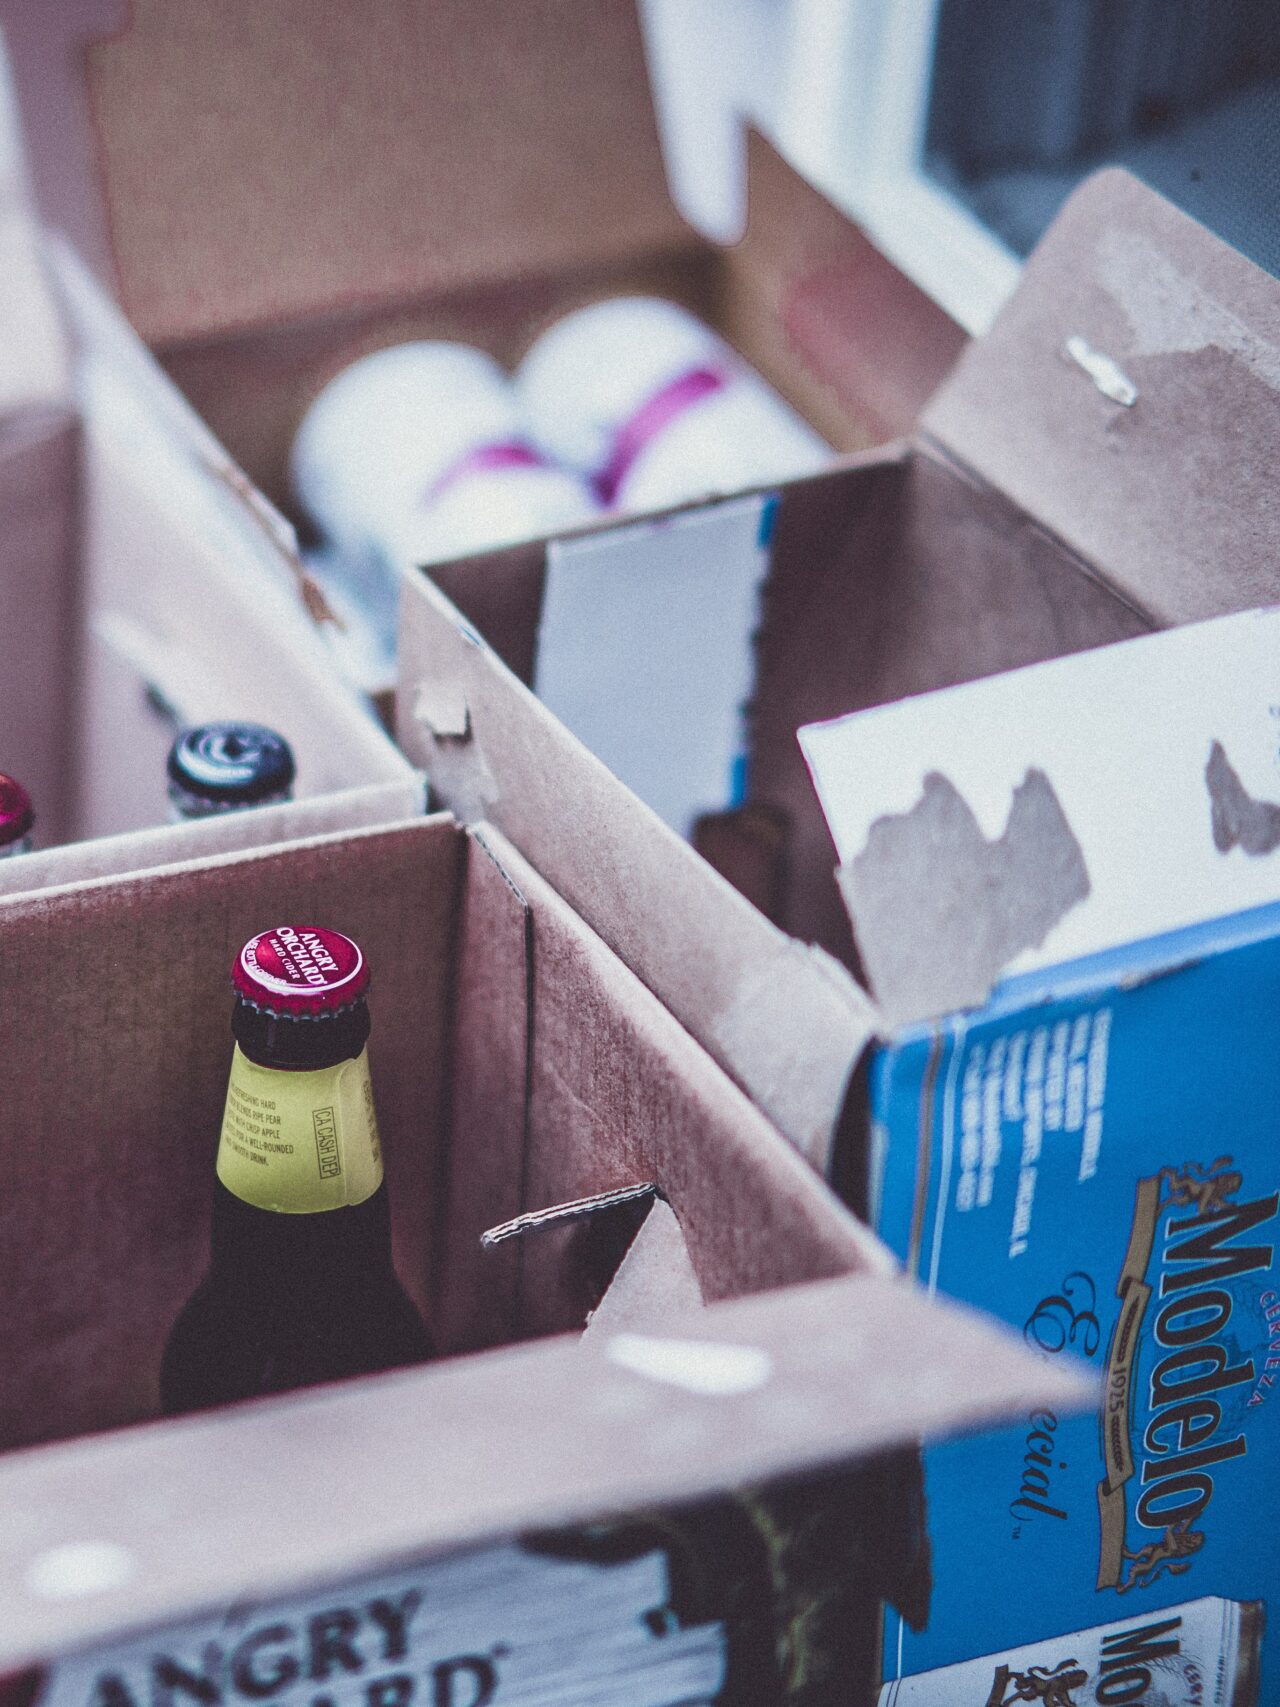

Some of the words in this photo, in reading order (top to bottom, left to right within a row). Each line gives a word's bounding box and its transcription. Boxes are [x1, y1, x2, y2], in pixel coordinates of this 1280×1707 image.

[268, 938, 286, 957] HARD
[281, 958, 301, 980] CIDER
[276, 926, 325, 985] ORCHARD
[298, 932, 339, 972] ANGRY
[260, 1100, 277, 1111] HARD
[265, 1114, 282, 1126] PEAR
[315, 1111, 332, 1126] CA
[249, 1138, 295, 1155] WELL-ROUNDED
[261, 1128, 281, 1140] APPLE
[317, 1127, 336, 1155] CASH
[321, 1156, 339, 1178] DEP
[1135, 1190, 1280, 1529] Modelo
[1246, 1290, 1280, 1407] CERVEZA
[1008, 1271, 1101, 1521] Eecial
[1109, 1367, 1127, 1413] 1925
